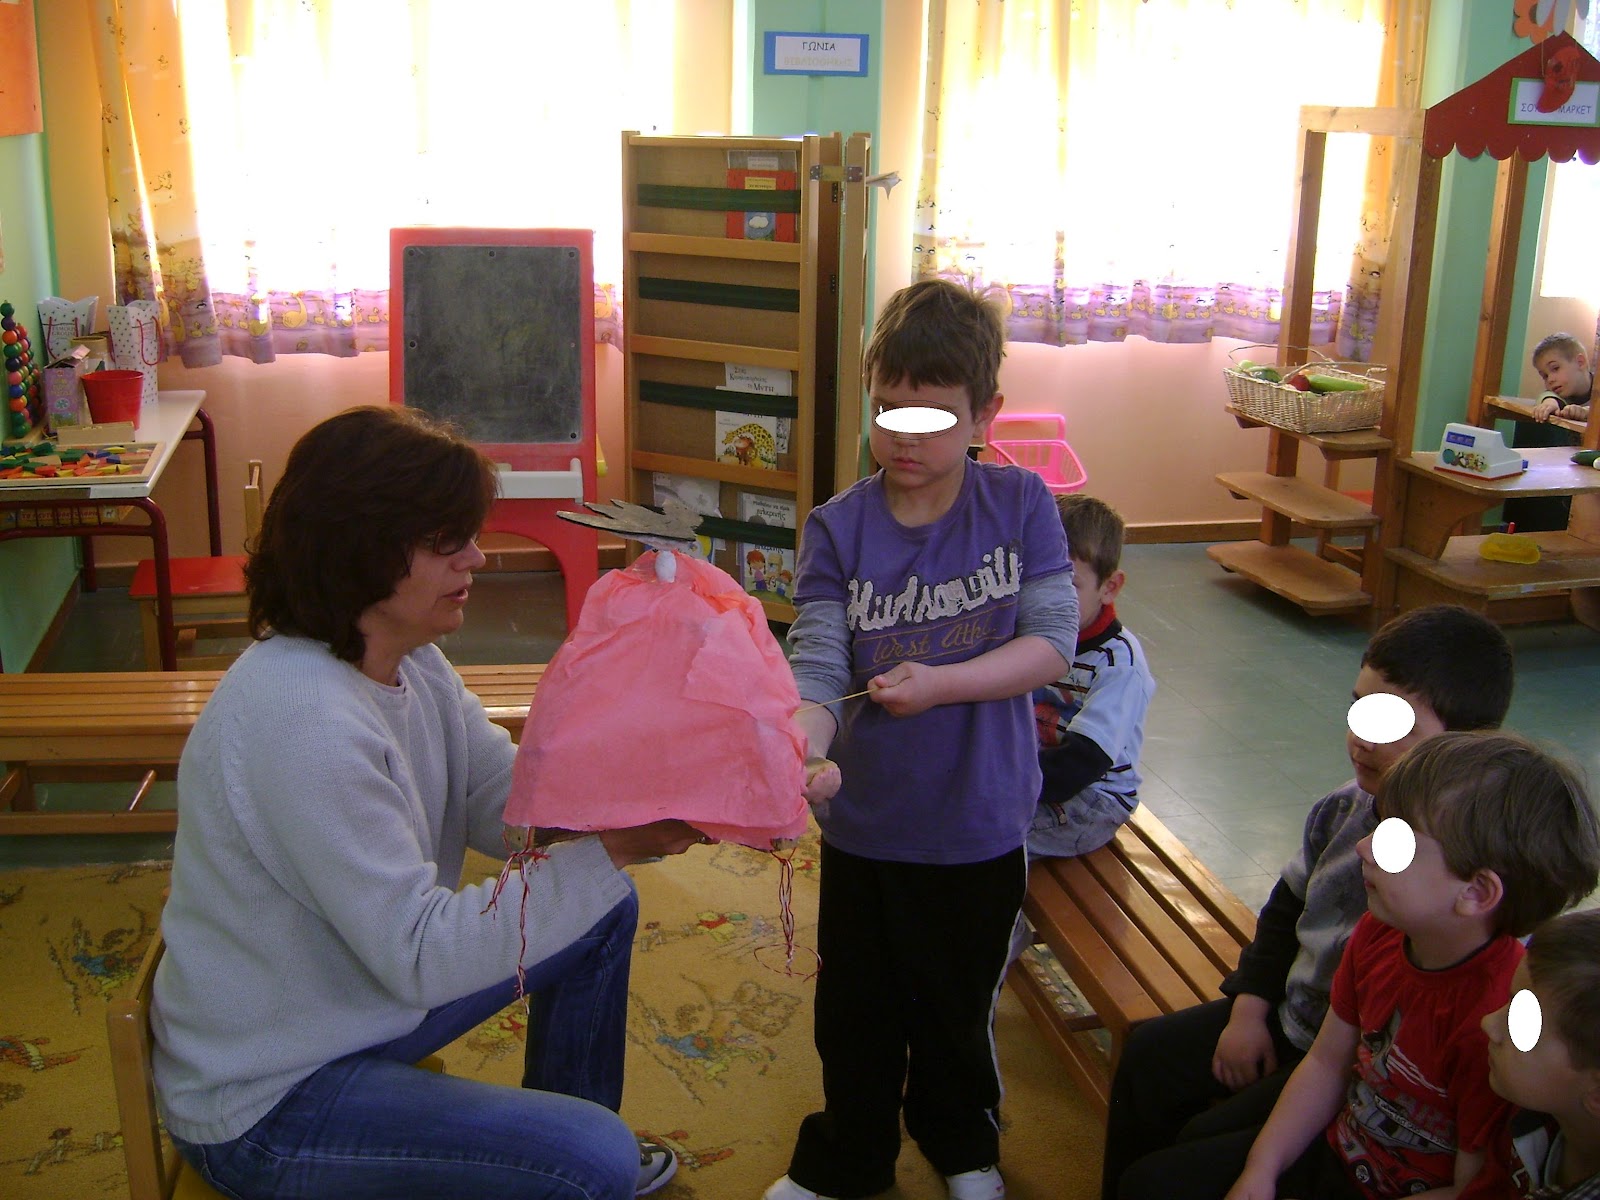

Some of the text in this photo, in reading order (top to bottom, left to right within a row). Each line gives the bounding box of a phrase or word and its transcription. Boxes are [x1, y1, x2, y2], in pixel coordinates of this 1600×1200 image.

[802, 41, 836, 51] ΓΩΝΙΑ
[1558, 104, 1592, 115] ΜΑΡΚΕΤ
[873, 634, 931, 664] West
